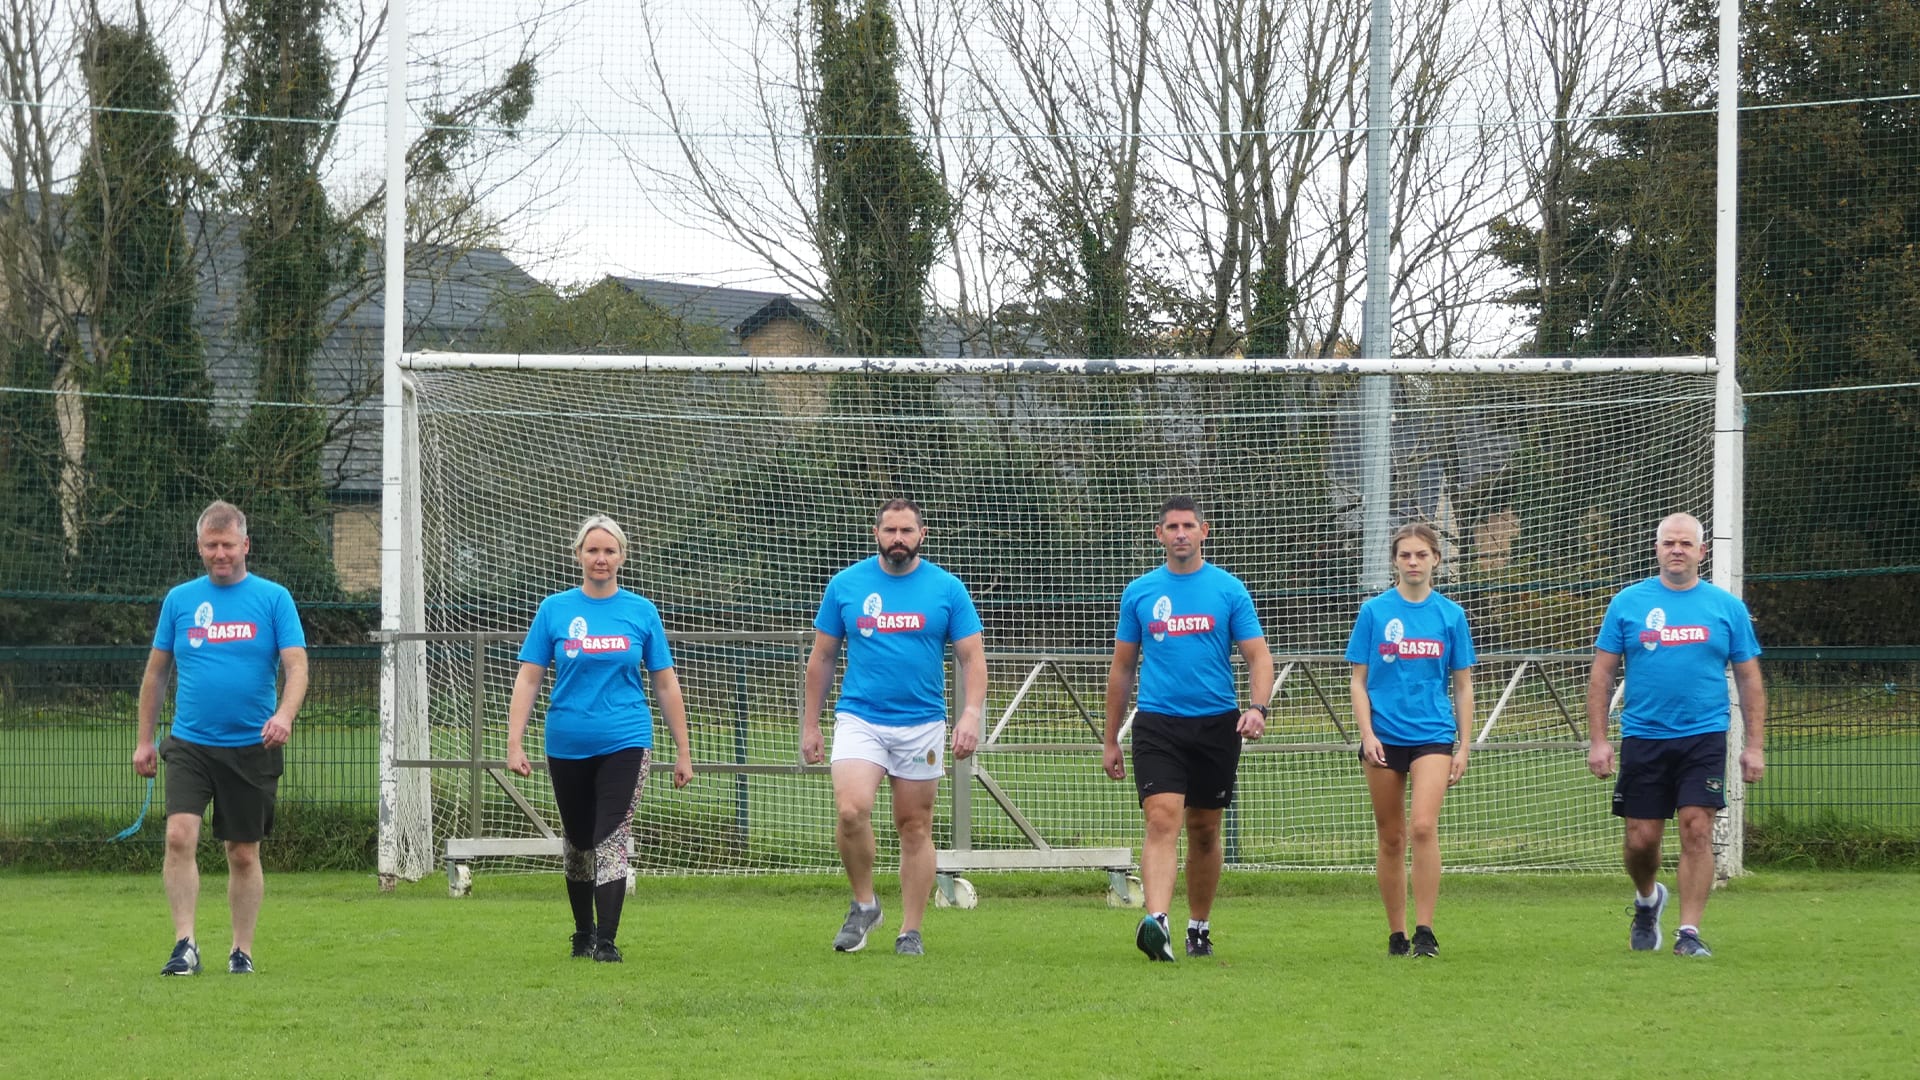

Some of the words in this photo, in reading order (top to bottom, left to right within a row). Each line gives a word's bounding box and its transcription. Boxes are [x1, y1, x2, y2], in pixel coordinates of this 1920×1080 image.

[878, 616, 920, 628] GASTA
[1167, 617, 1209, 631] GASTA
[207, 625, 252, 638] GASTA
[1660, 628, 1704, 641] GASTA
[583, 638, 626, 649] GASTA
[1399, 642, 1440, 655] GASTA
